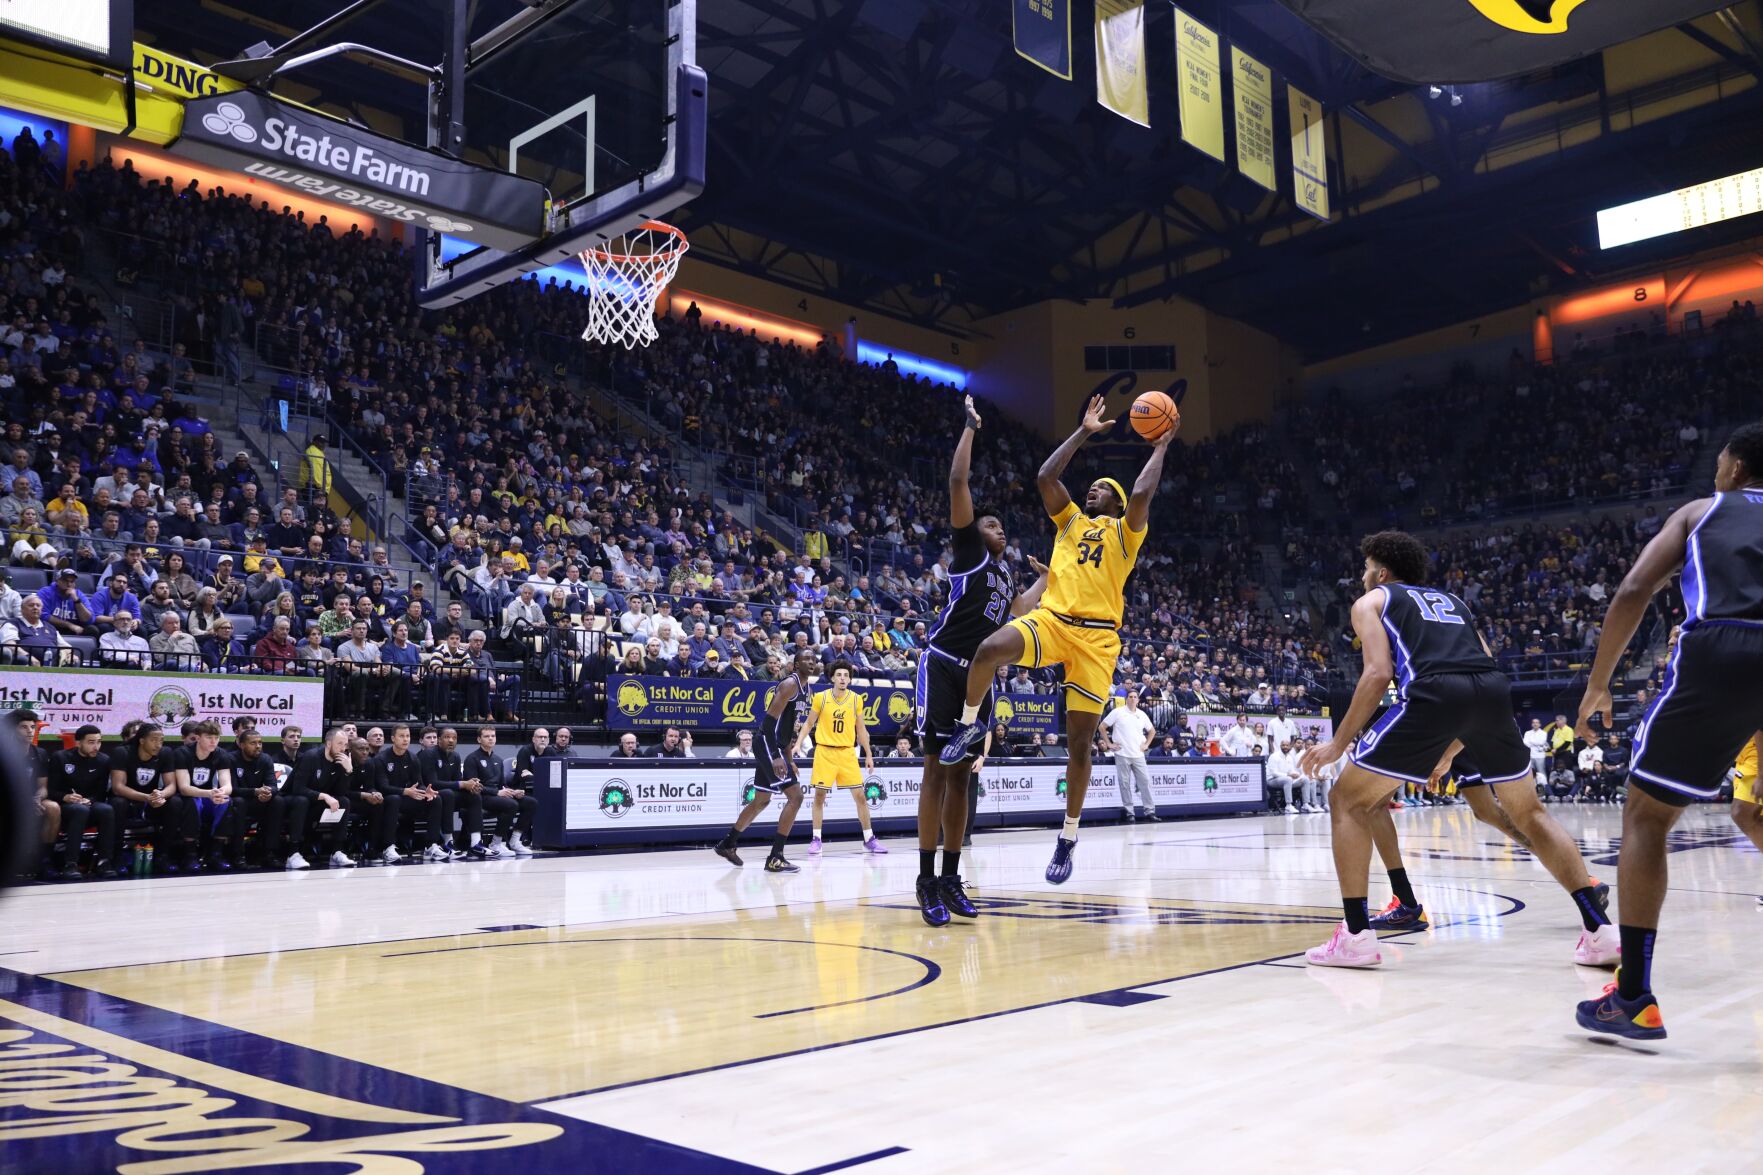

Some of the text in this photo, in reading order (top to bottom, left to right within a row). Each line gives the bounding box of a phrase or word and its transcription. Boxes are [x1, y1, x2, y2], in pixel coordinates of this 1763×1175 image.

[1634, 288, 1647, 301] 8
[798, 299, 808, 312] 4
[1123, 327, 1136, 339] 6
[951, 342, 960, 355] 5
[1081, 528, 1105, 541] Cal
[1077, 542, 1104, 569] 34
[984, 592, 1006, 625] 21
[1407, 590, 1465, 624] 12
[0, 687, 113, 706] 1st Nor Cal
[649, 686, 714, 701] 1st Nor Cal
[199, 693, 294, 710] 1st Nor Cal
[722, 686, 756, 723] Cal
[1014, 701, 1055, 713] 1st Nor Cal
[62, 713, 104, 723] UNION
[833, 720, 844, 733] 10
[987, 777, 1033, 790] 1st Nor Cal
[1104, 775, 1116, 787] Cal
[1152, 774, 1187, 785] 1st Nor Cal
[1218, 774, 1227, 783] 1st
[1228, 774, 1239, 783] Nor
[636, 782, 707, 798] 1st Nor Cal
[889, 780, 903, 792] 1st
[642, 804, 702, 813] CREDIT UNION
